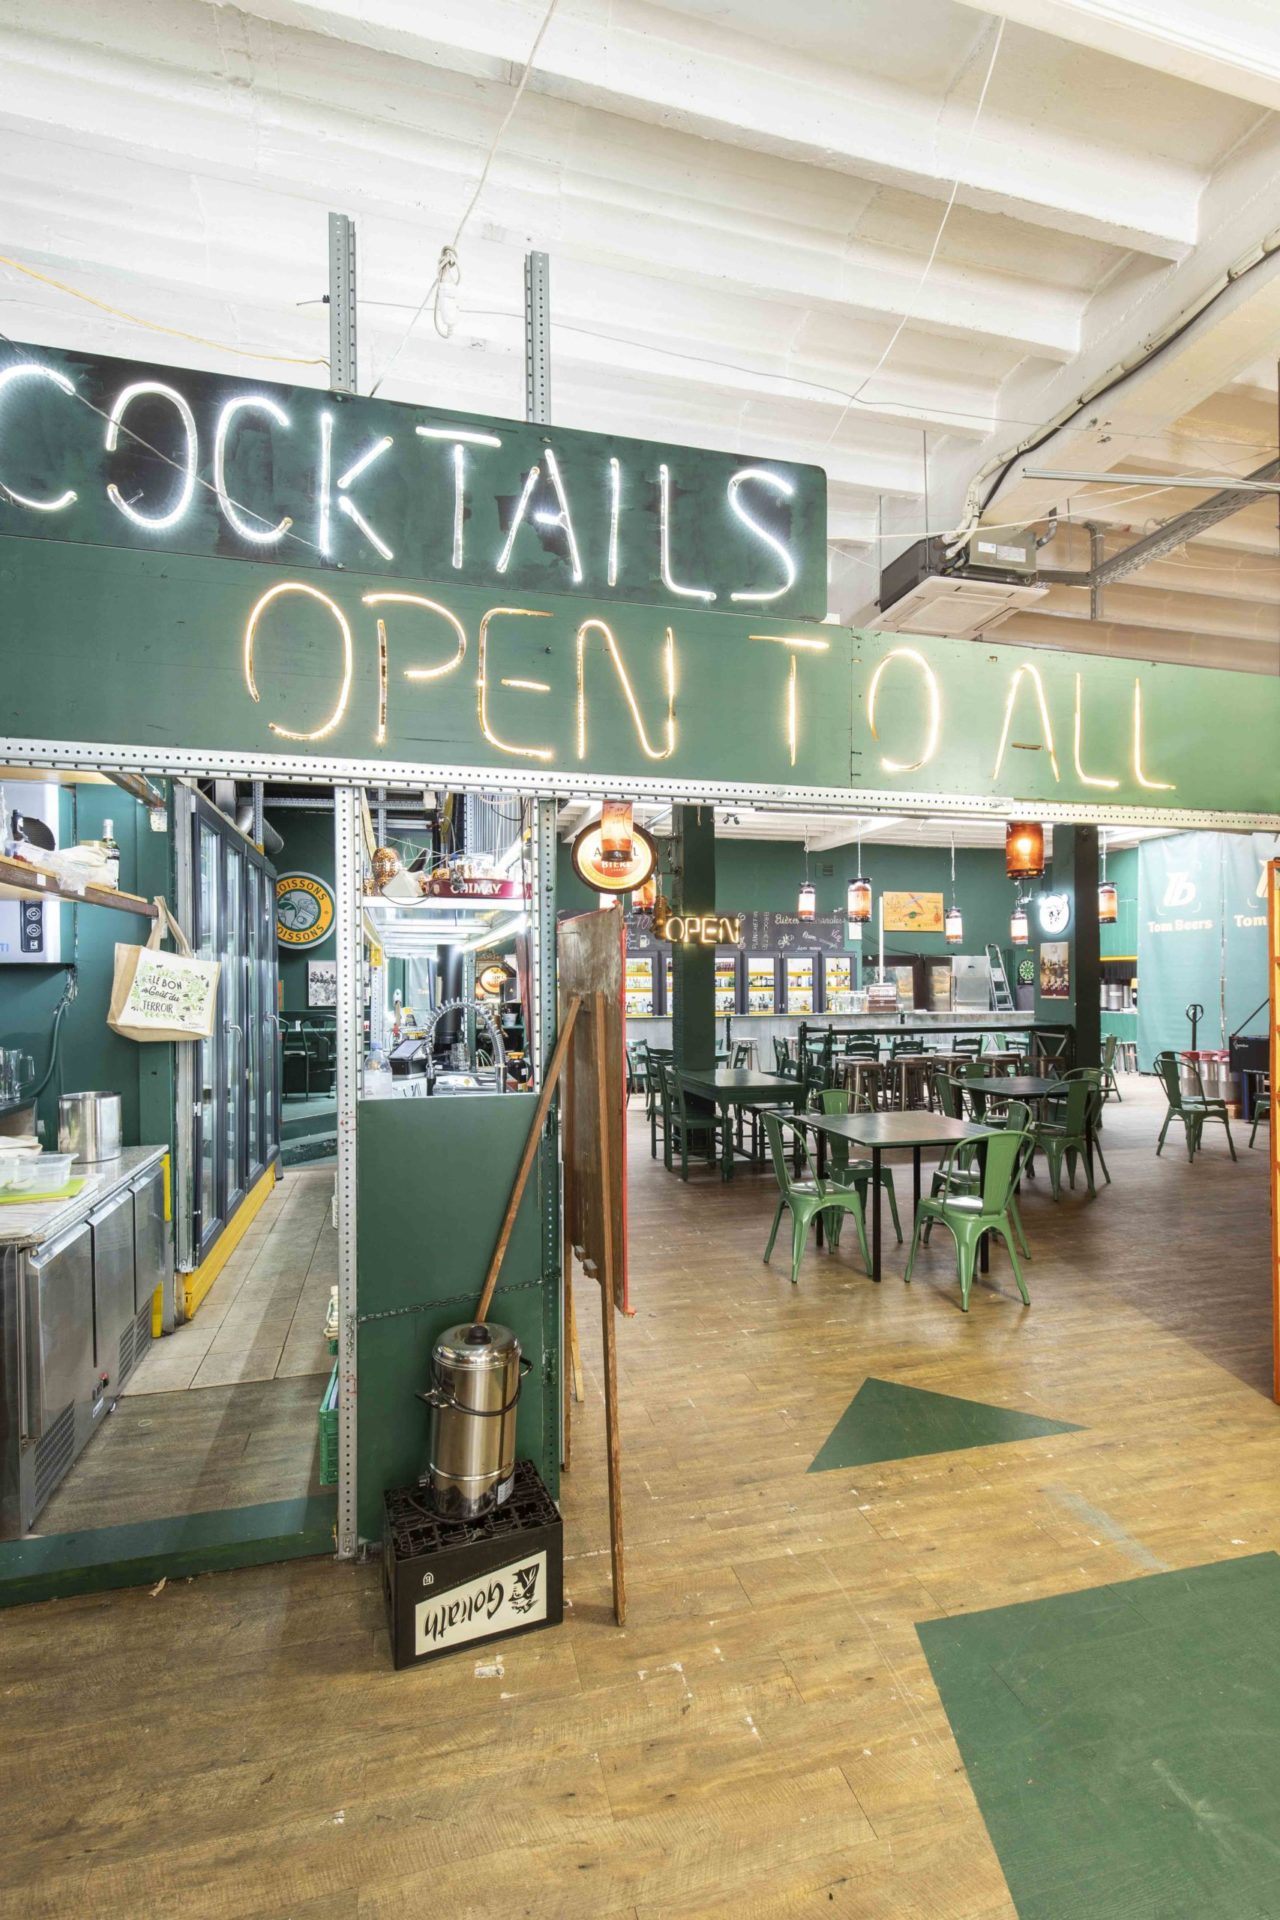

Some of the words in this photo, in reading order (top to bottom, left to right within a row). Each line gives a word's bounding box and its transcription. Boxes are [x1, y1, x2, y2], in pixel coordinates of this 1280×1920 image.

[0, 364, 797, 602] COCKTAILS
[244, 582, 678, 761] OPEN
[748, 634, 941, 772] TO
[993, 662, 1178, 790] ALL
[665, 916, 740, 944] OPEN
[1148, 921, 1173, 933] Tom
[1234, 914, 1268, 928] Tom
[276, 924, 325, 942] OISSONS
[162, 979, 182, 990] BON
[143, 1000, 174, 1014] TERROIR
[424, 1582, 505, 1642] Goliath
